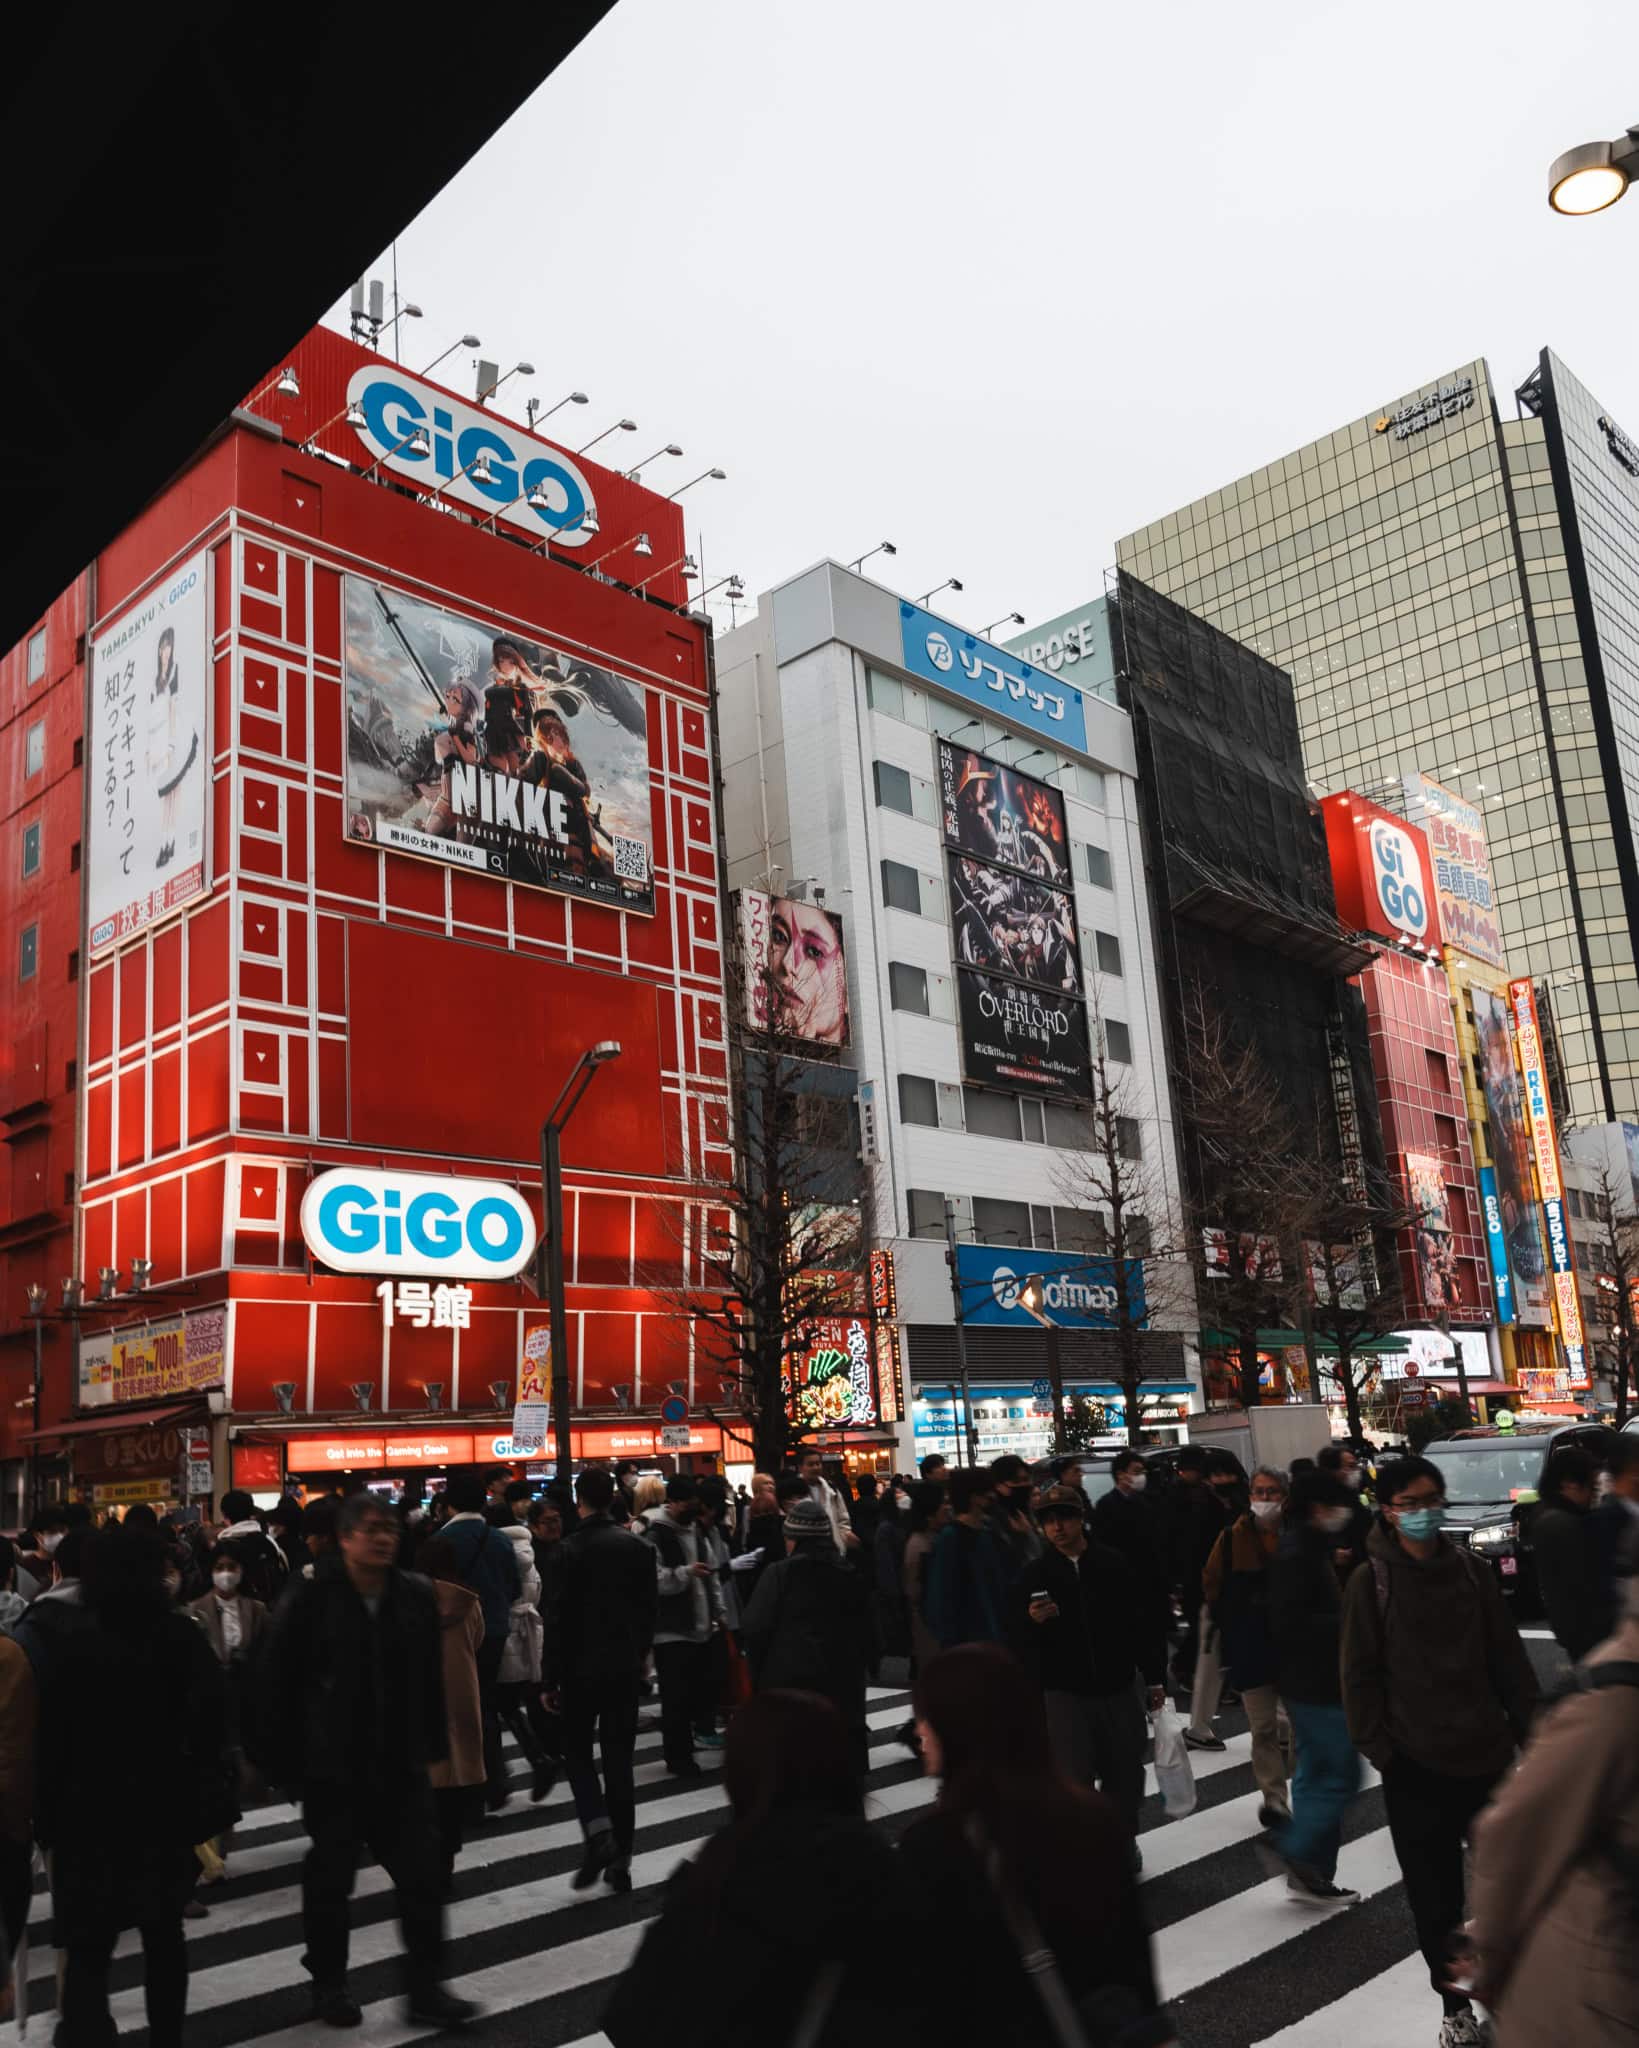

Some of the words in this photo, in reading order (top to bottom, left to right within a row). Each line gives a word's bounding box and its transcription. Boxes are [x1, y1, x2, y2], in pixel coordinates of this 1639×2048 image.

[362, 381, 585, 531] GiGO
[168, 572, 198, 604] GiGO
[958, 649, 1065, 720] ソフマップ
[451, 760, 569, 845] NIKKE
[1376, 828, 1404, 878] Gi
[1381, 874, 1424, 928] GO
[978, 989, 1069, 1036] OVERLORD
[319, 1184, 524, 1263] GiGO
[1485, 1195, 1501, 1234] GiGO
[376, 1281, 473, 1329] 1号館
[1026, 1273, 1119, 1318] ofmap
[327, 1447, 346, 1459] Get
[367, 1445, 383, 1457] the
[386, 1445, 422, 1457] Gaming
